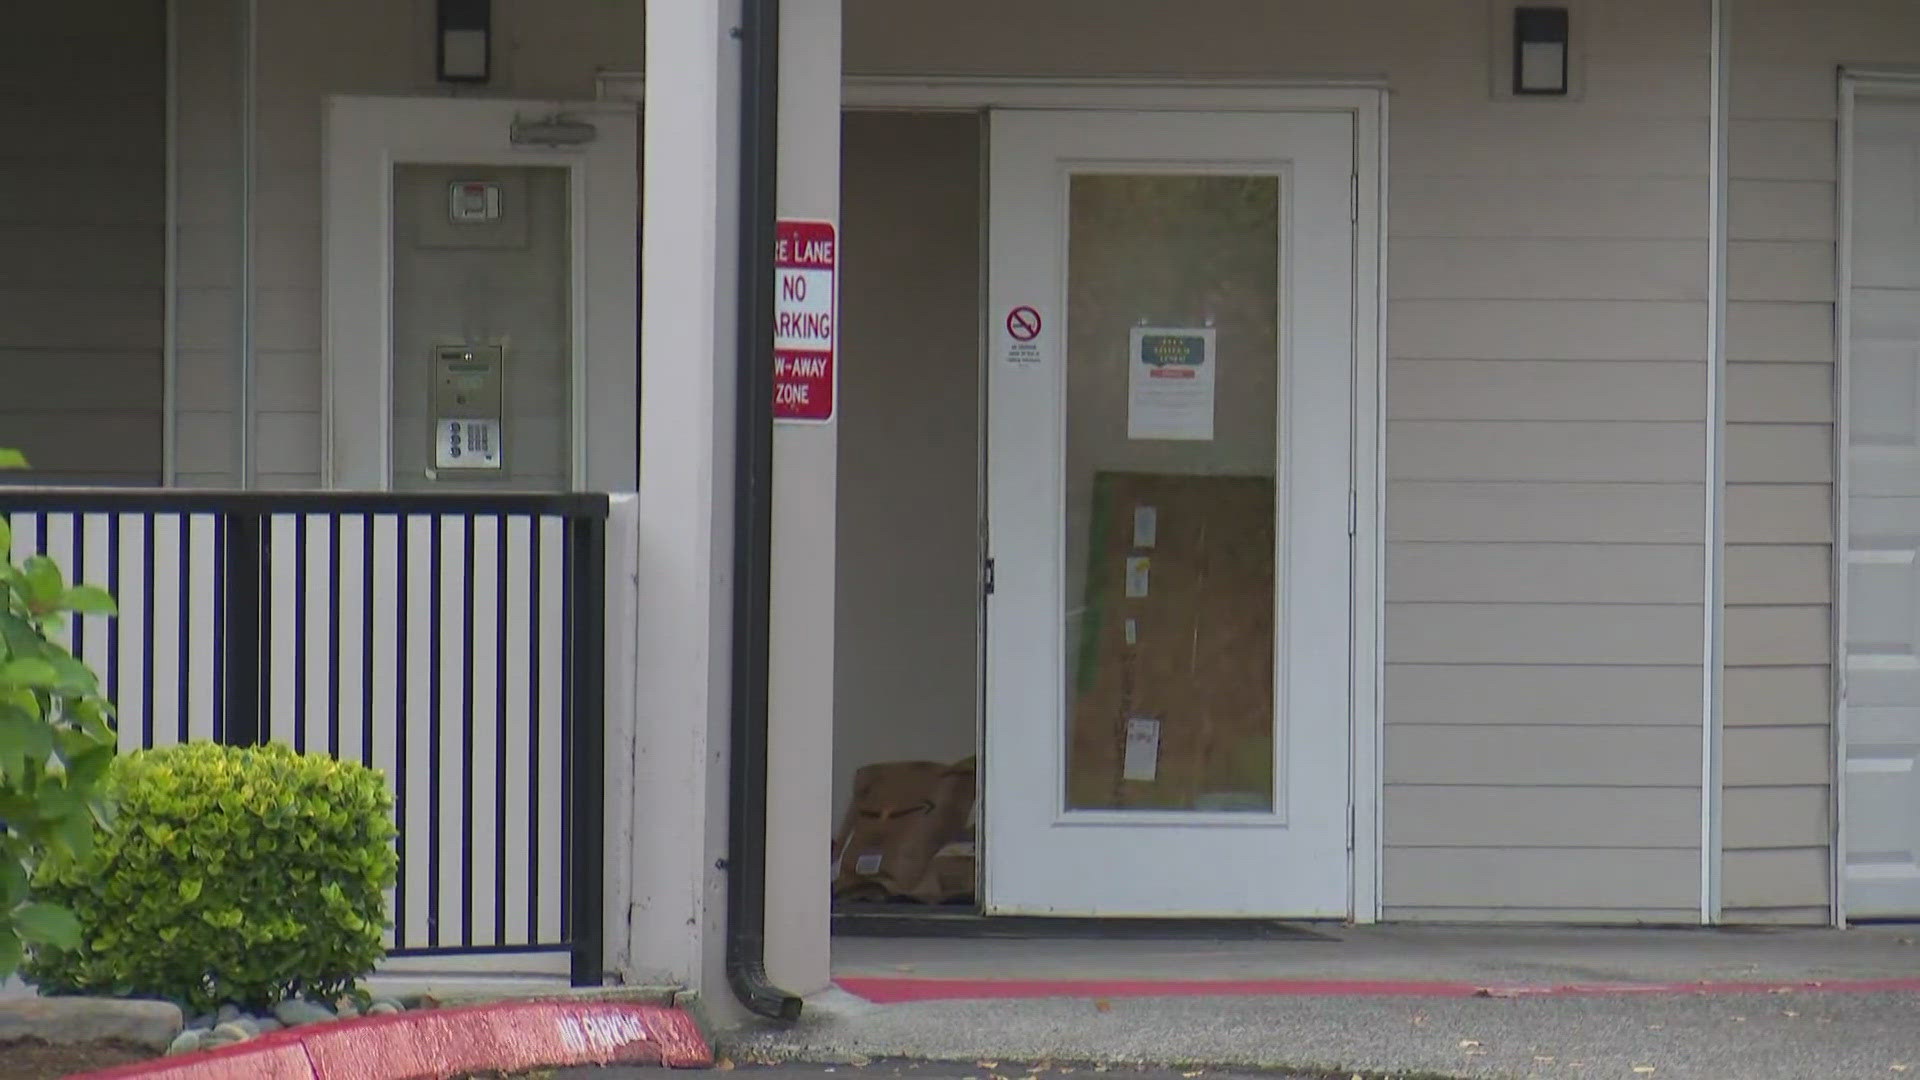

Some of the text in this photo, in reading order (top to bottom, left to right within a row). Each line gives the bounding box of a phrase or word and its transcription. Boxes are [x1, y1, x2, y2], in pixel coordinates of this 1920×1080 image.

[793, 239, 832, 264] LANE
[783, 275, 806, 302] NO
[774, 356, 827, 378] W-AWAY
[775, 382, 809, 405] ZONE
